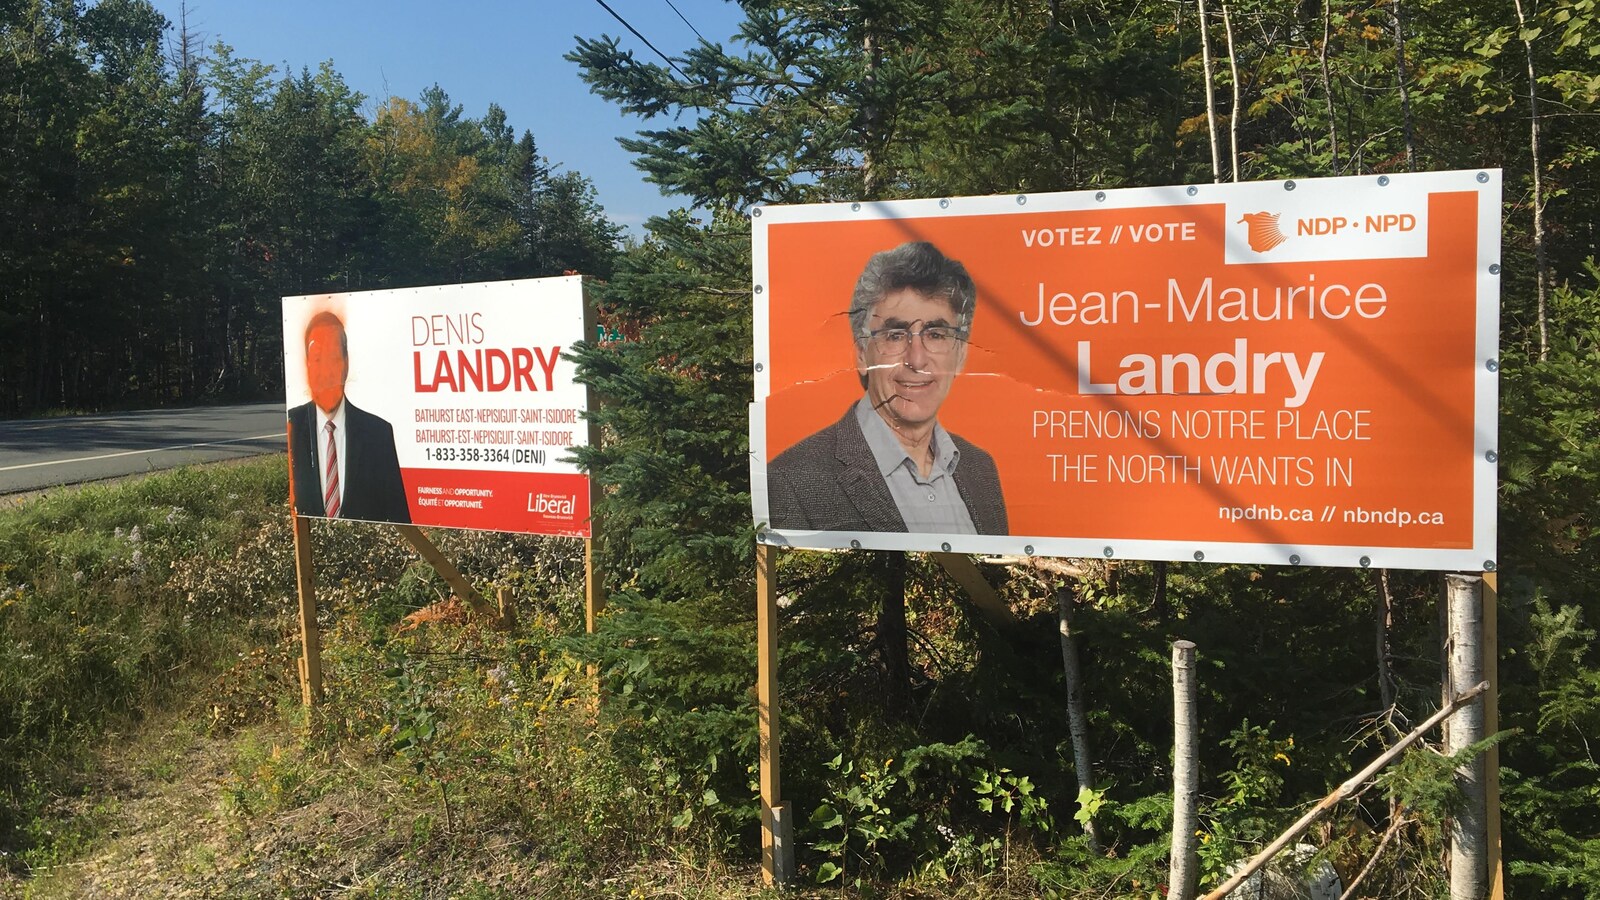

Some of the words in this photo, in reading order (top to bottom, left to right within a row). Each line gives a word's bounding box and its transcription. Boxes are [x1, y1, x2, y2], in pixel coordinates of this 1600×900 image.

[1022, 227, 1102, 248] VOTEZ
[1129, 222, 1196, 243] VOTE
[1298, 217, 1347, 236] NDP
[1366, 213, 1417, 234] NPD
[1019, 274, 1388, 327] Jean-Maurice
[412, 313, 484, 346] DENIS
[413, 346, 561, 393] LANDRY
[1077, 338, 1325, 408] Landry
[415, 408, 454, 423] BATHURST
[456, 408, 577, 424] EAST-NEPISIGUIT-SAINT-ISIDORE
[1033, 410, 1161, 439] PRENONS
[1171, 410, 1265, 439] NOTRE
[1277, 410, 1371, 440] PLACE
[416, 429, 573, 446] BATHURST-EST-NEPISIGUIT-SAINT-ISIDORE
[426, 448, 509, 463] 1-833-358-3364
[512, 449, 546, 466] (DENI)
[1047, 455, 1098, 482] THE
[1107, 455, 1201, 484] NORTH
[1211, 456, 1314, 486] WANTS
[1326, 458, 1353, 487] IN
[417, 486, 442, 495] FAIRNESS
[418, 496, 438, 507] ÉQUITÉ
[527, 492, 576, 514] Liberal
[1218, 504, 1314, 523] npdnb.ca
[1343, 507, 1445, 528] nbndp.ca
